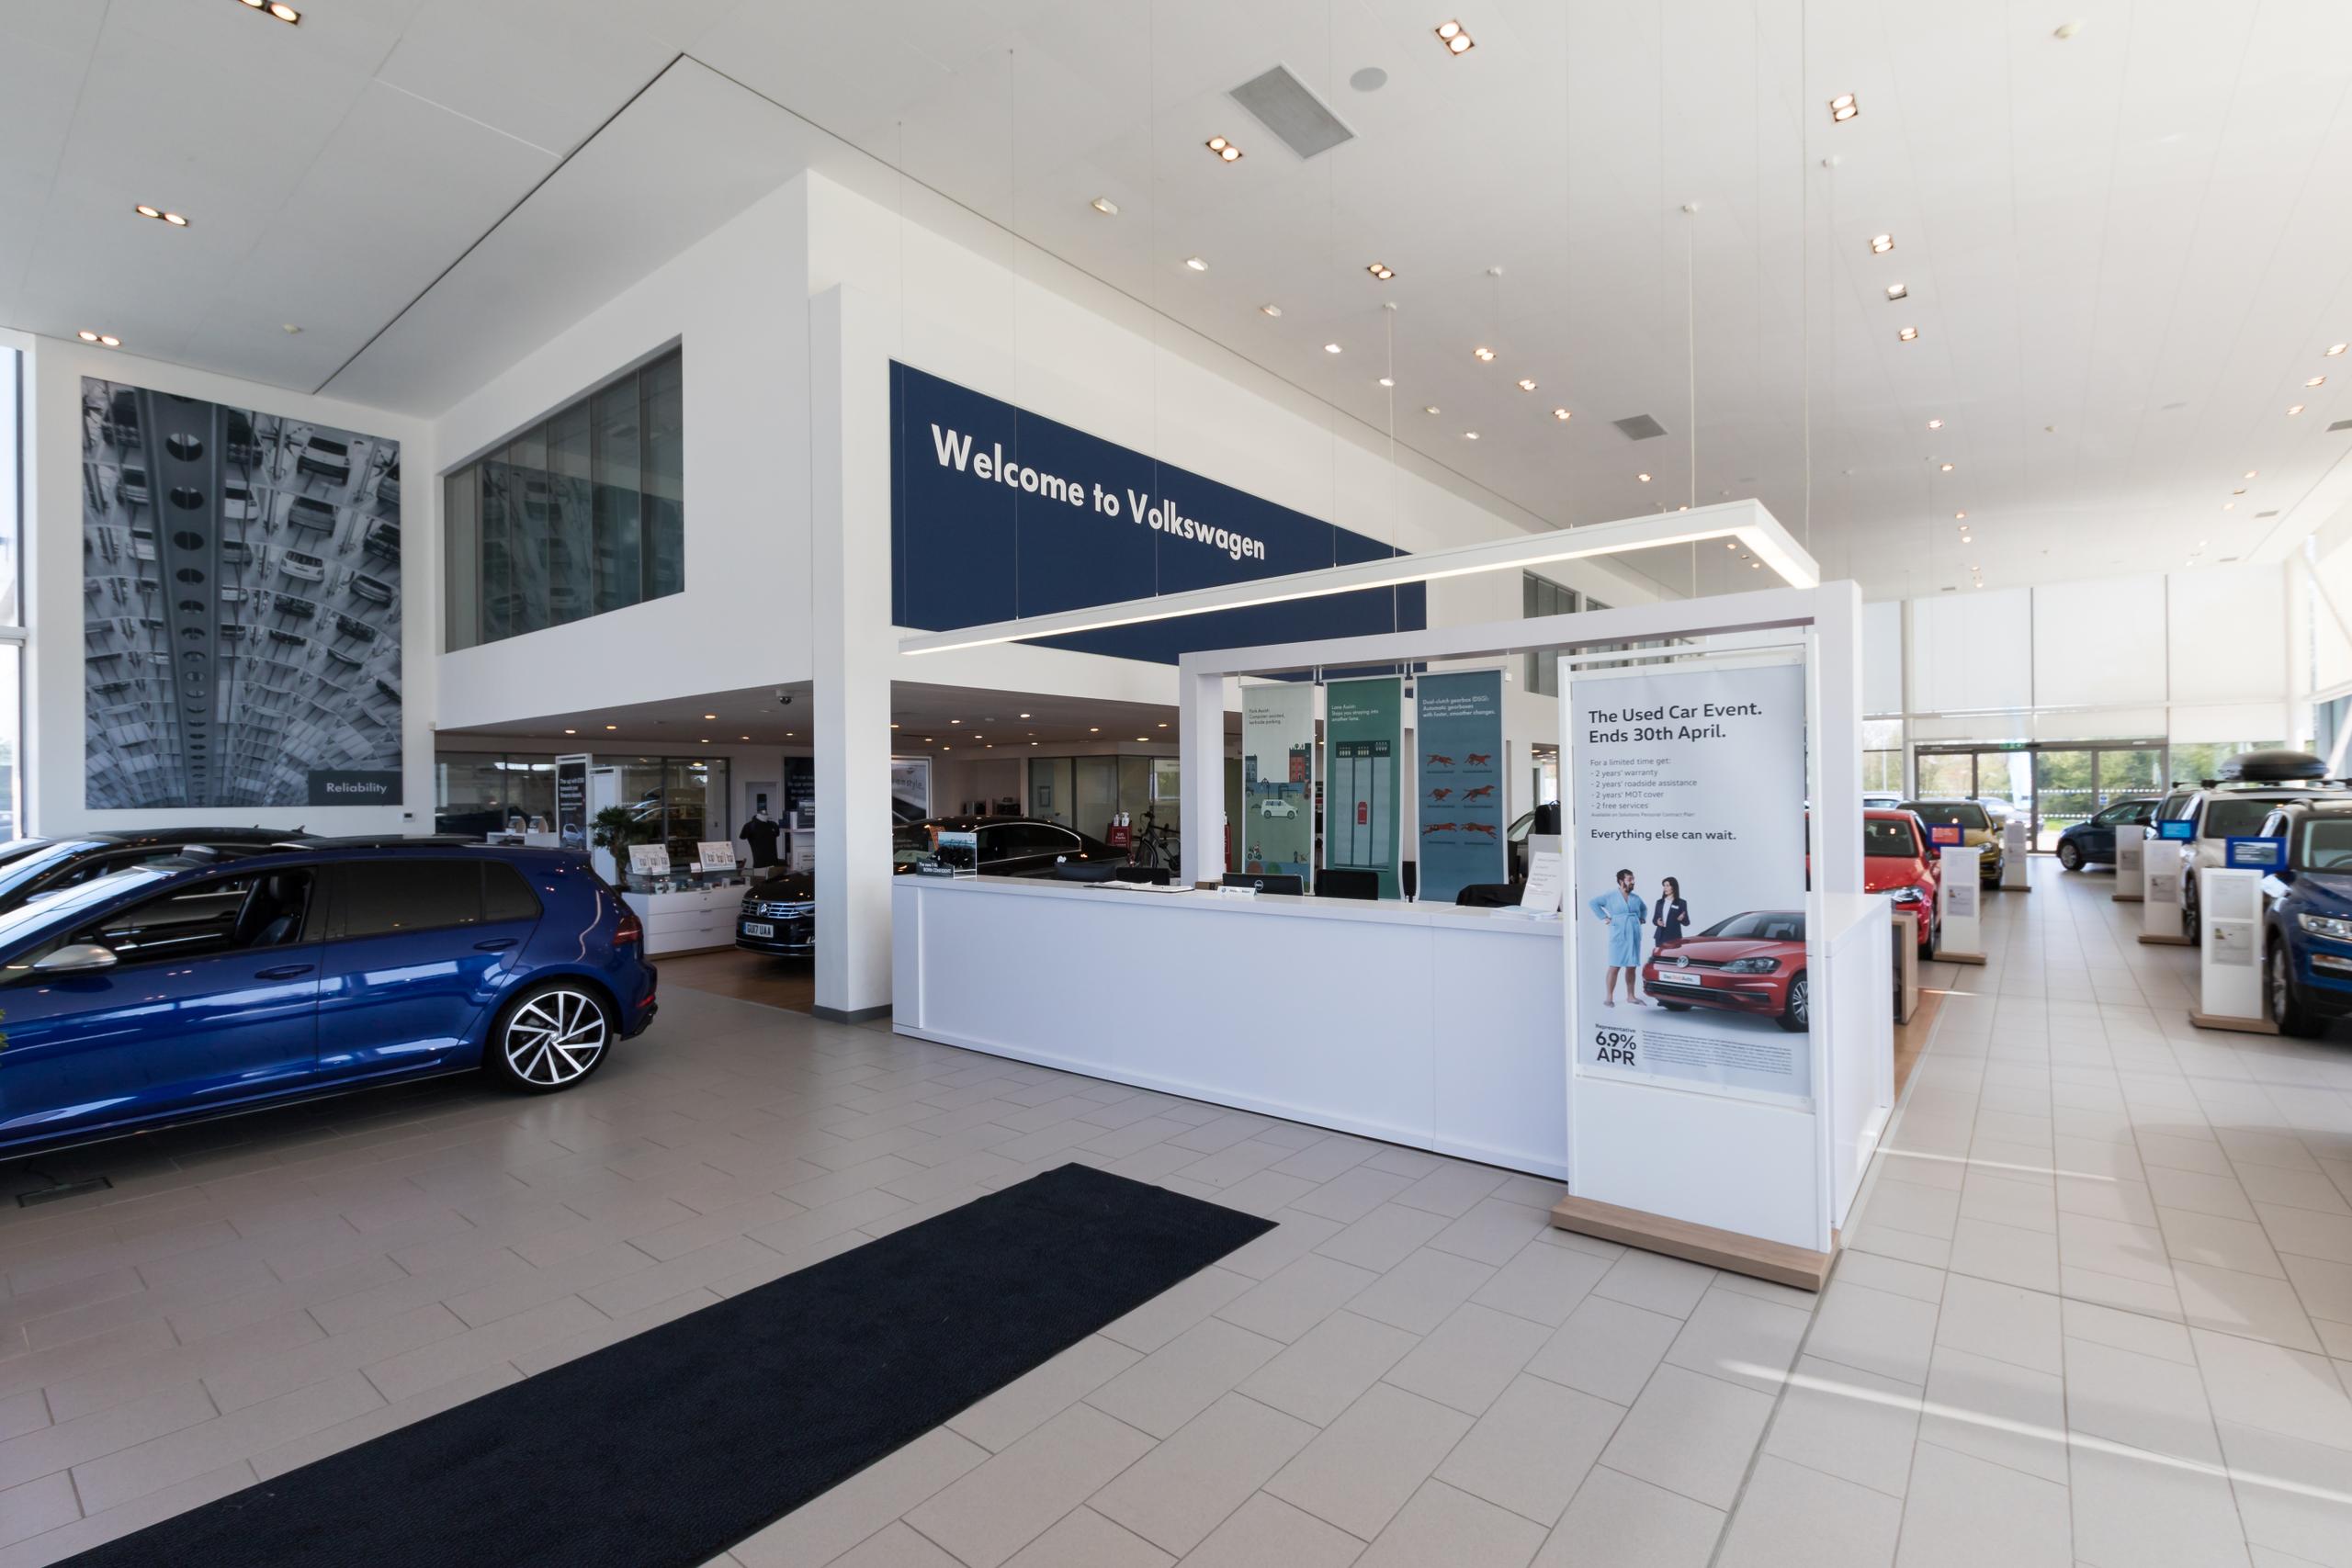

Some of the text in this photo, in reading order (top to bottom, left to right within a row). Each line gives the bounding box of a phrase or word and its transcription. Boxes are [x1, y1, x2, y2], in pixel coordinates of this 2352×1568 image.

[931, 423, 1265, 560] Welcome to Volkswagen
[1589, 703, 1762, 723] The Used Car Event.
[1589, 724, 1726, 743] Ends 30th April.
[1656, 758, 1671, 766] get:
[1624, 770, 1658, 778] warranty
[326, 782, 387, 795] Reliability
[1624, 779, 1657, 787] roadside
[1657, 779, 1697, 787] assistance
[1590, 829, 1736, 840] Everything else can wait.
[1595, 1031, 1637, 1050] 6.9%
[1597, 1046, 1635, 1066] APR
